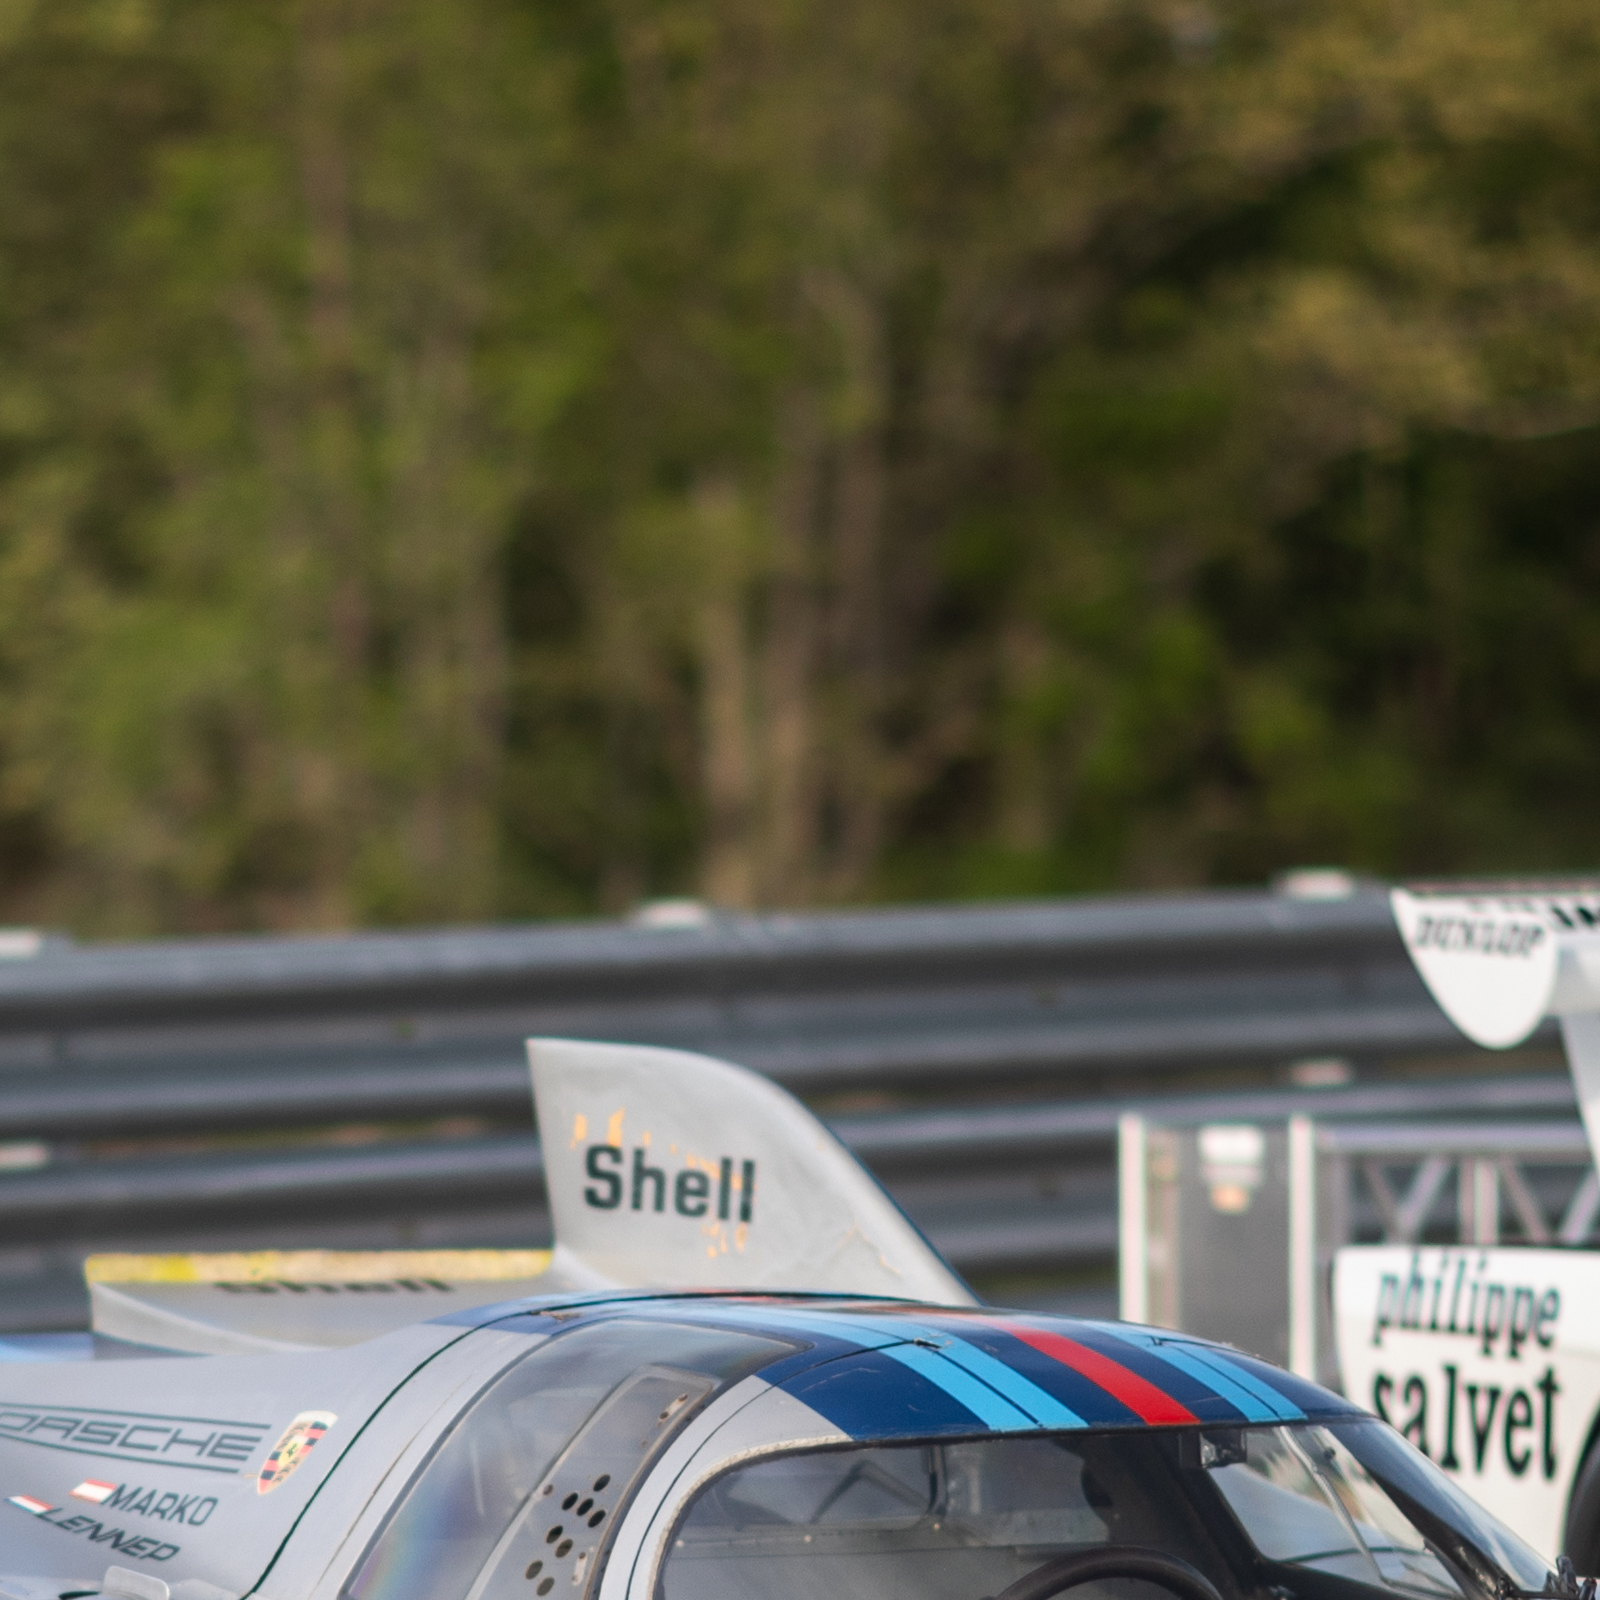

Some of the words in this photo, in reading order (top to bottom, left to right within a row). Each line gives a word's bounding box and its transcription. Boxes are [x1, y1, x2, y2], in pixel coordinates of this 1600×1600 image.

[583, 1144, 756, 1222] Shell
[1373, 1251, 1560, 1359] philippe
[36, 1506, 180, 1562] LENNEP
[102, 1482, 218, 1527] MARKO
